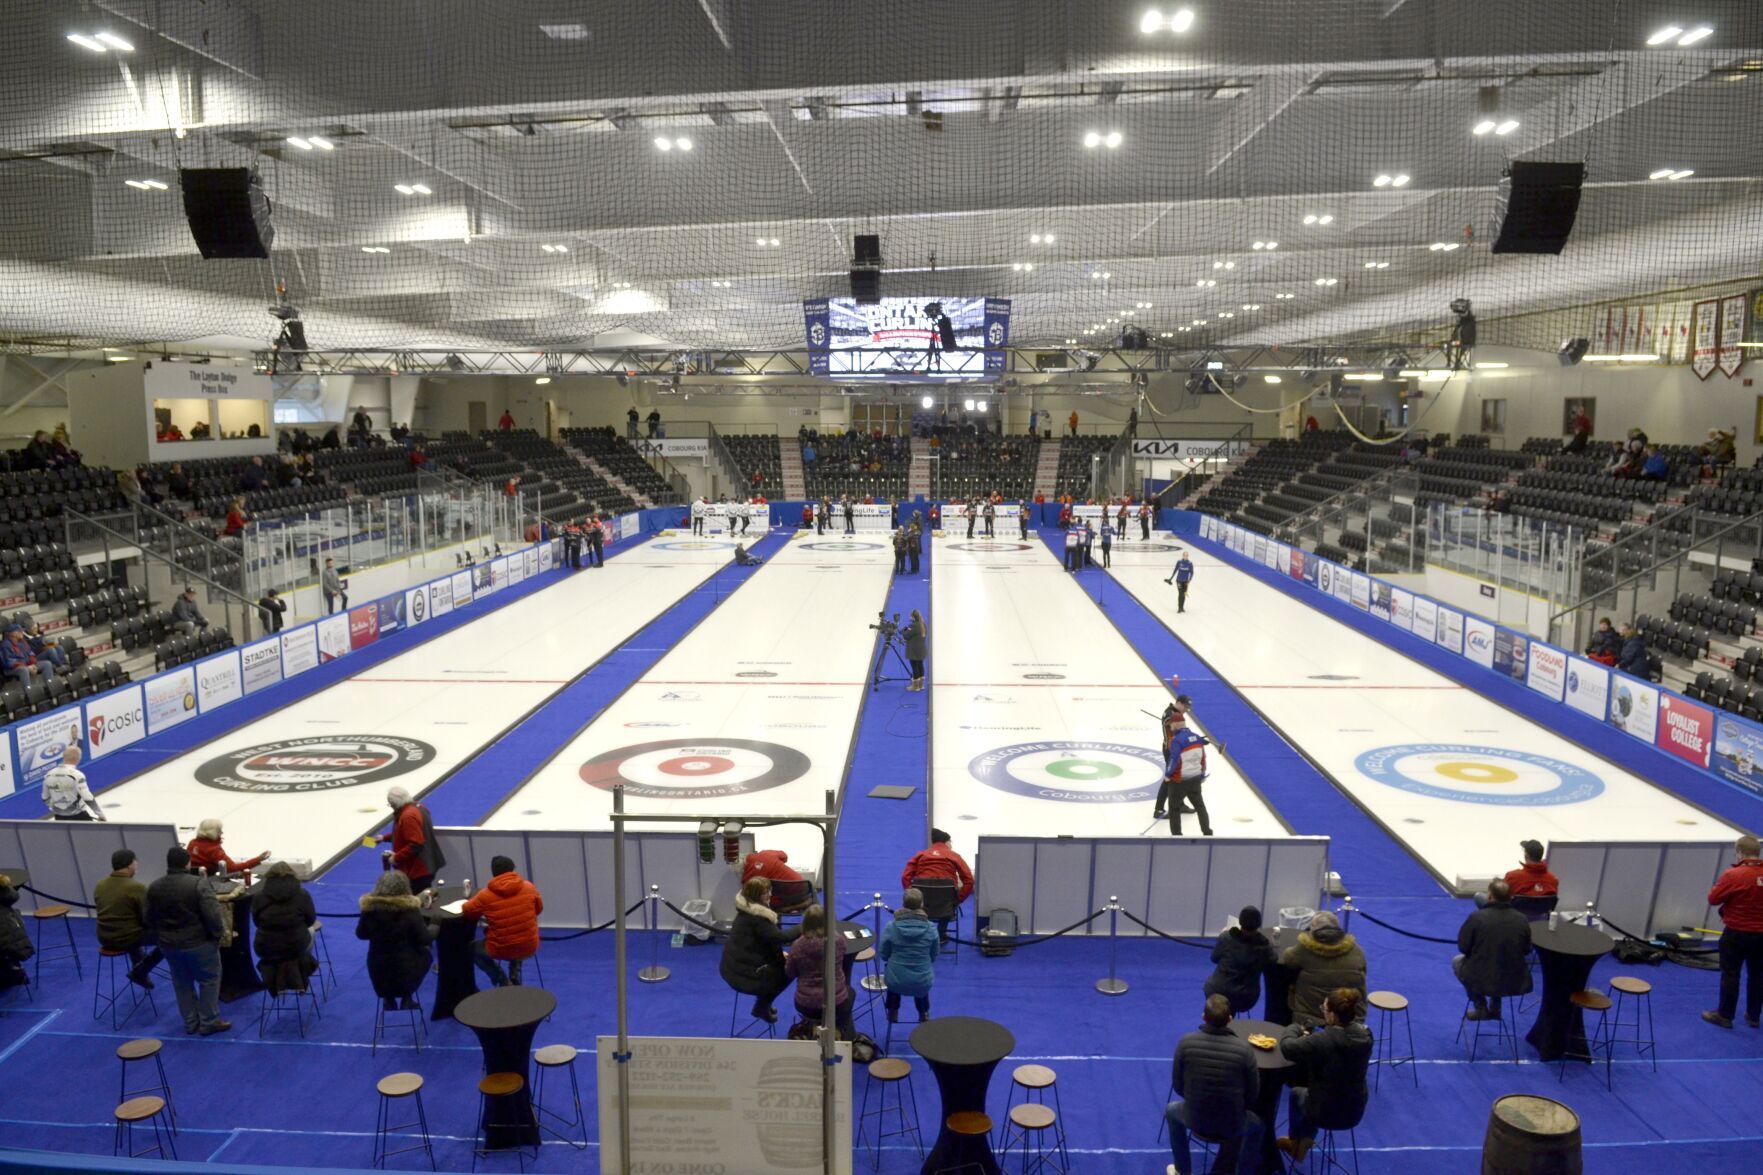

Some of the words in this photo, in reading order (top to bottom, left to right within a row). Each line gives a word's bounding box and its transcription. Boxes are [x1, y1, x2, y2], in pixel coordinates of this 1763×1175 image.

[190, 370, 200, 380] The
[202, 384, 216, 393] Press
[1186, 447, 1229, 456] COBOURG
[244, 645, 278, 664] STADTKE
[1532, 644, 1564, 669] FOODLAND
[1580, 679, 1606, 697] ELLIOTT
[108, 709, 142, 733] COSIC
[1666, 710, 1700, 735] LOYALIST
[230, 742, 286, 759] WEST
[288, 736, 424, 762] NORTHUMBERLAND
[1670, 727, 1703, 753] COLLEGE
[264, 756, 375, 766] WNCC
[982, 743, 1048, 768] WELCOME
[1052, 742, 1140, 754] CURLING
[1364, 746, 1416, 775] WELCOME
[1416, 744, 1521, 759] CURLING
[213, 776, 289, 790] CURLING
[295, 778, 358, 790] CLUB
[1038, 790, 1150, 801] Cobourg.ca
